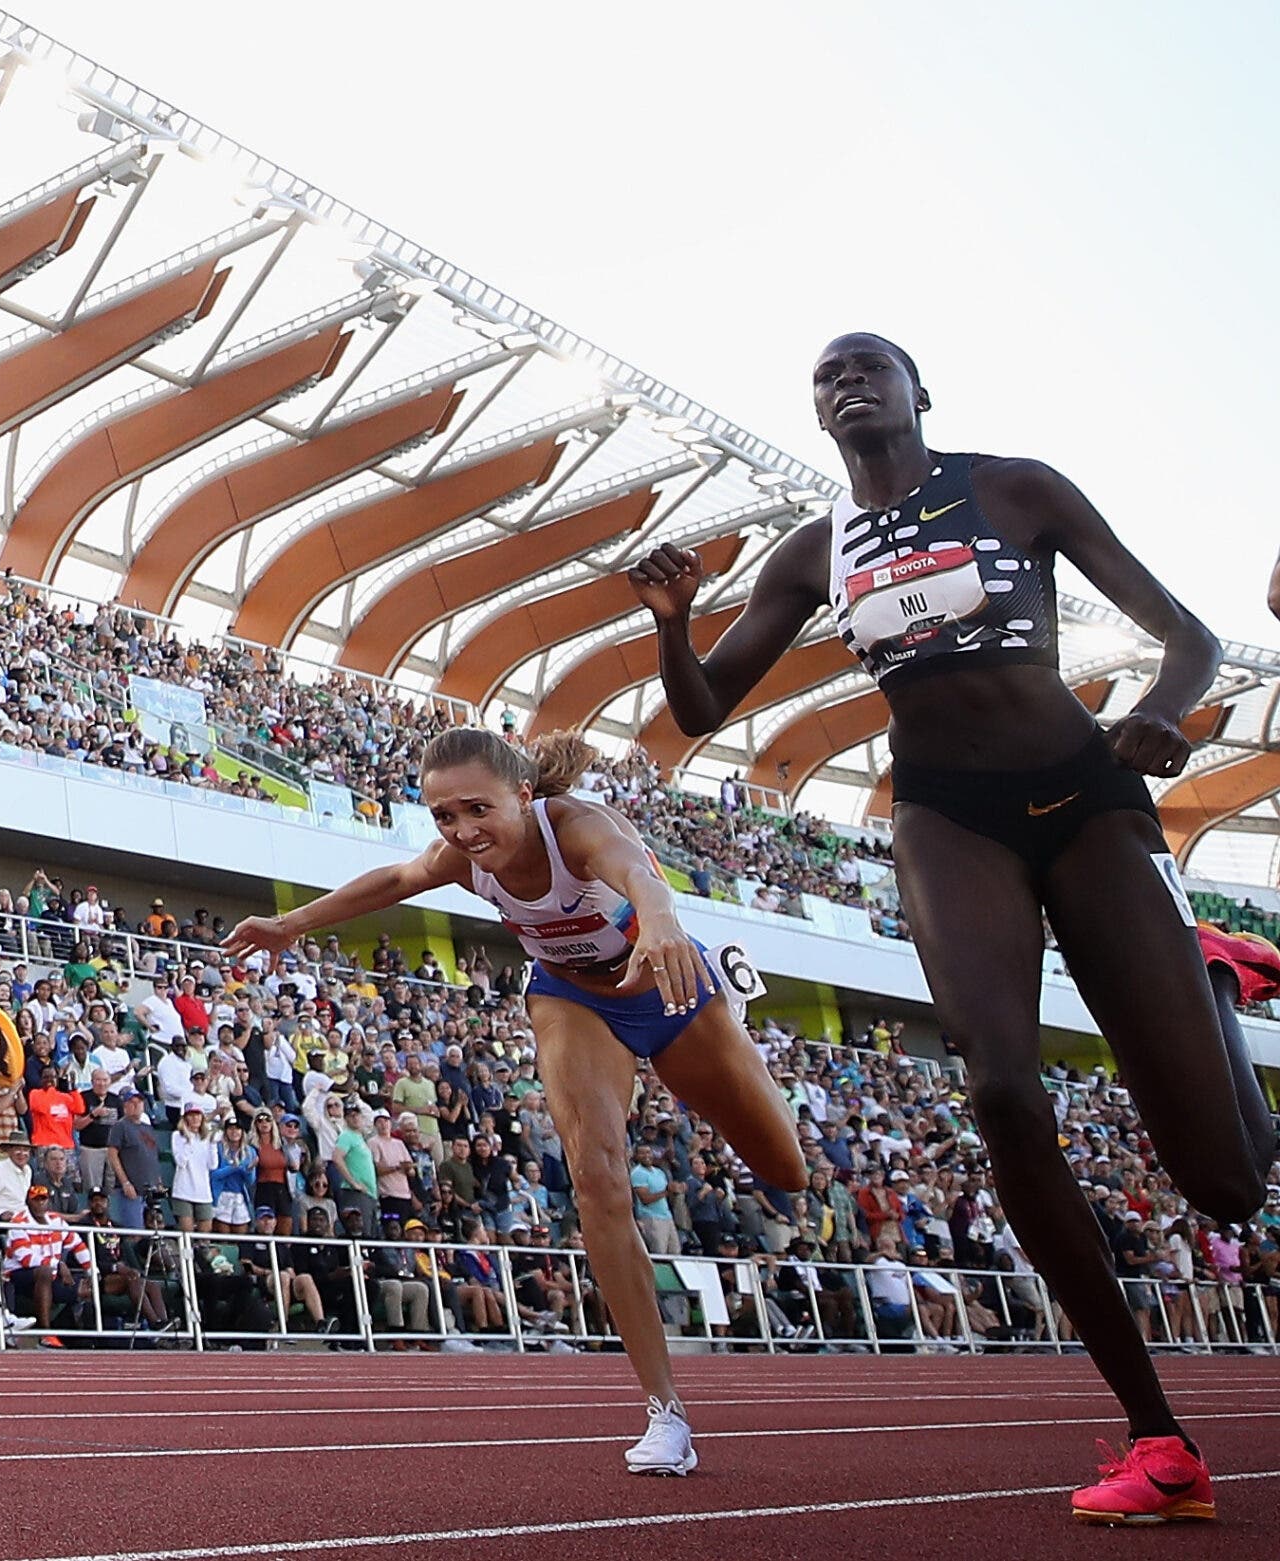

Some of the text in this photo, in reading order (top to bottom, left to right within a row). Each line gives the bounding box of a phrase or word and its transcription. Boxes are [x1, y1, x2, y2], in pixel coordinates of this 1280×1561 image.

[893, 557, 937, 577] TOYOTA
[899, 592, 928, 618] MU
[540, 925, 580, 935] TOYOTA
[720, 945, 756, 994] 6
